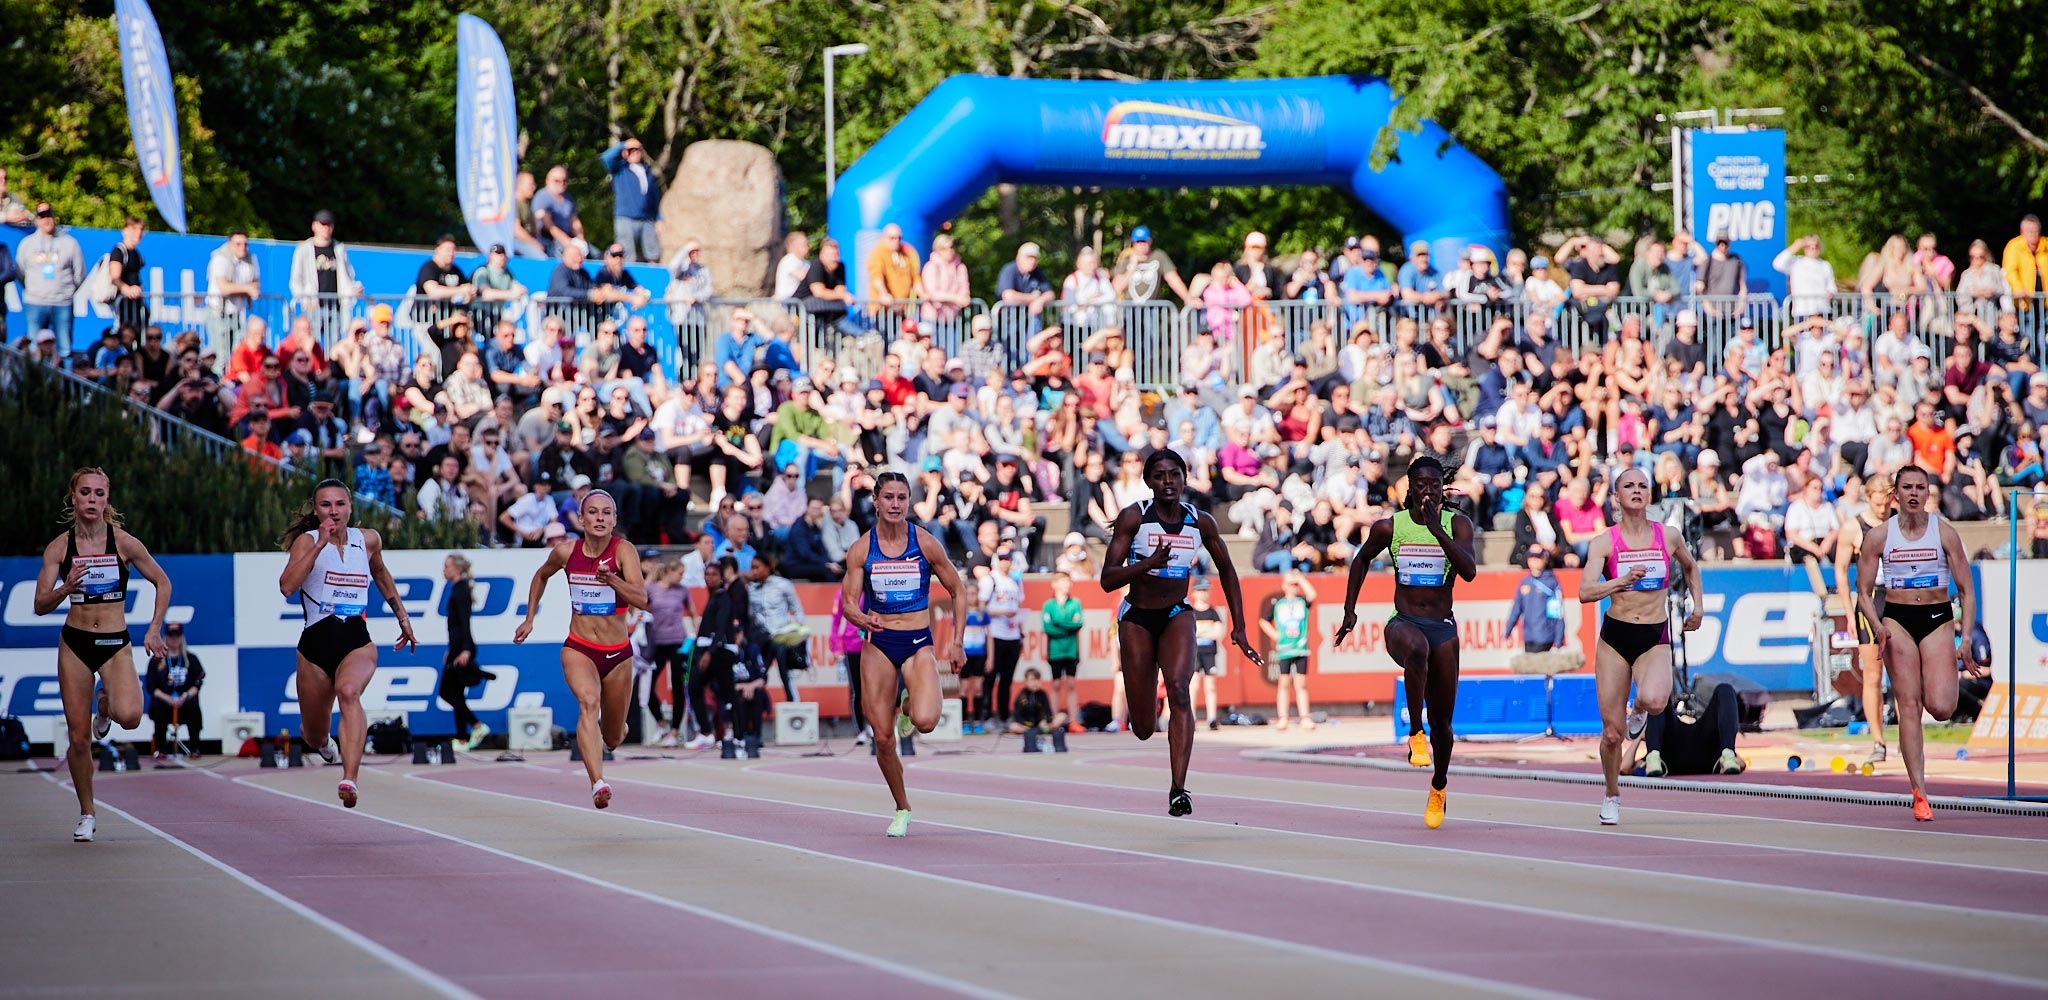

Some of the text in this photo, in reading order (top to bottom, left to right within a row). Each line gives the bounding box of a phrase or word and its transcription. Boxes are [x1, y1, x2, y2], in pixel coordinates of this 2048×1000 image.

[1104, 124, 1262, 150] maxim
[1706, 200, 1775, 242] PNG
[1408, 560, 1434, 569] Kwadwo
[884, 578, 907, 586] Lindner
[580, 589, 602, 598] Forster
